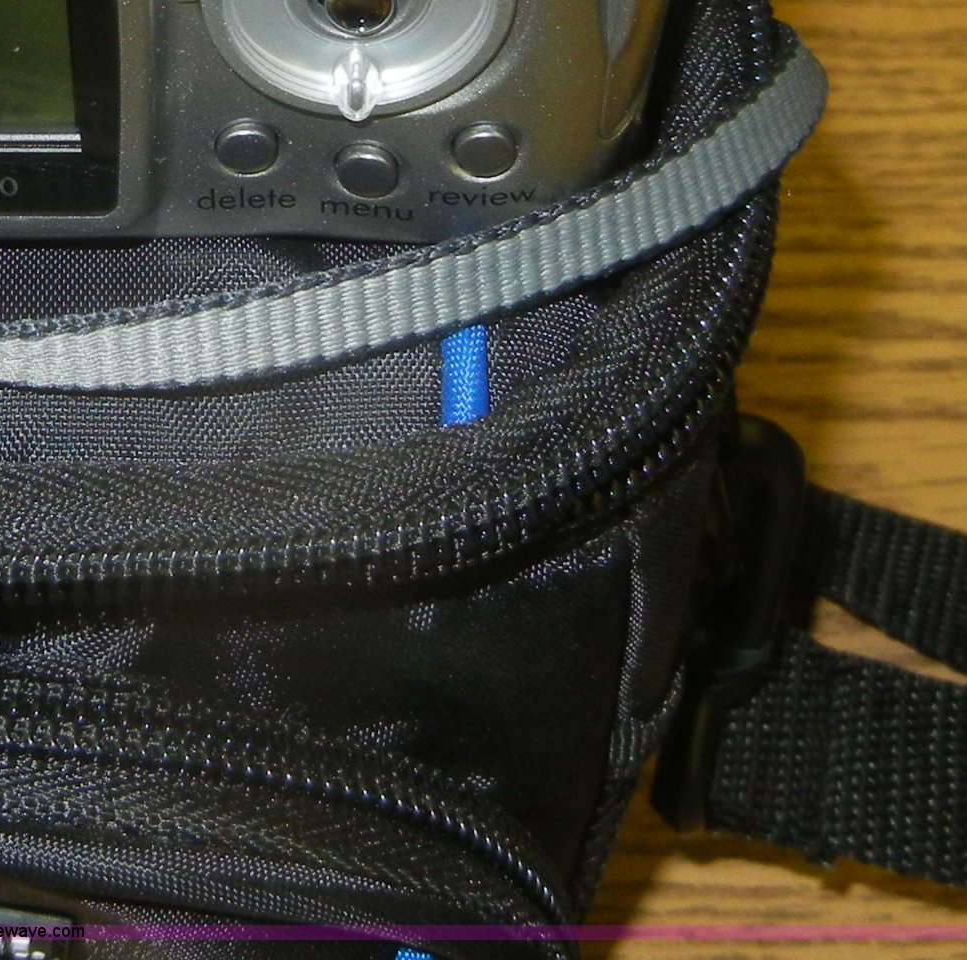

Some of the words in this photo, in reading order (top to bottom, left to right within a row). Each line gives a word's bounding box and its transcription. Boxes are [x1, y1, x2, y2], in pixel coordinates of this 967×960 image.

[196, 188, 297, 211] delete
[428, 186, 537, 207] review
[320, 197, 414, 222] menu
